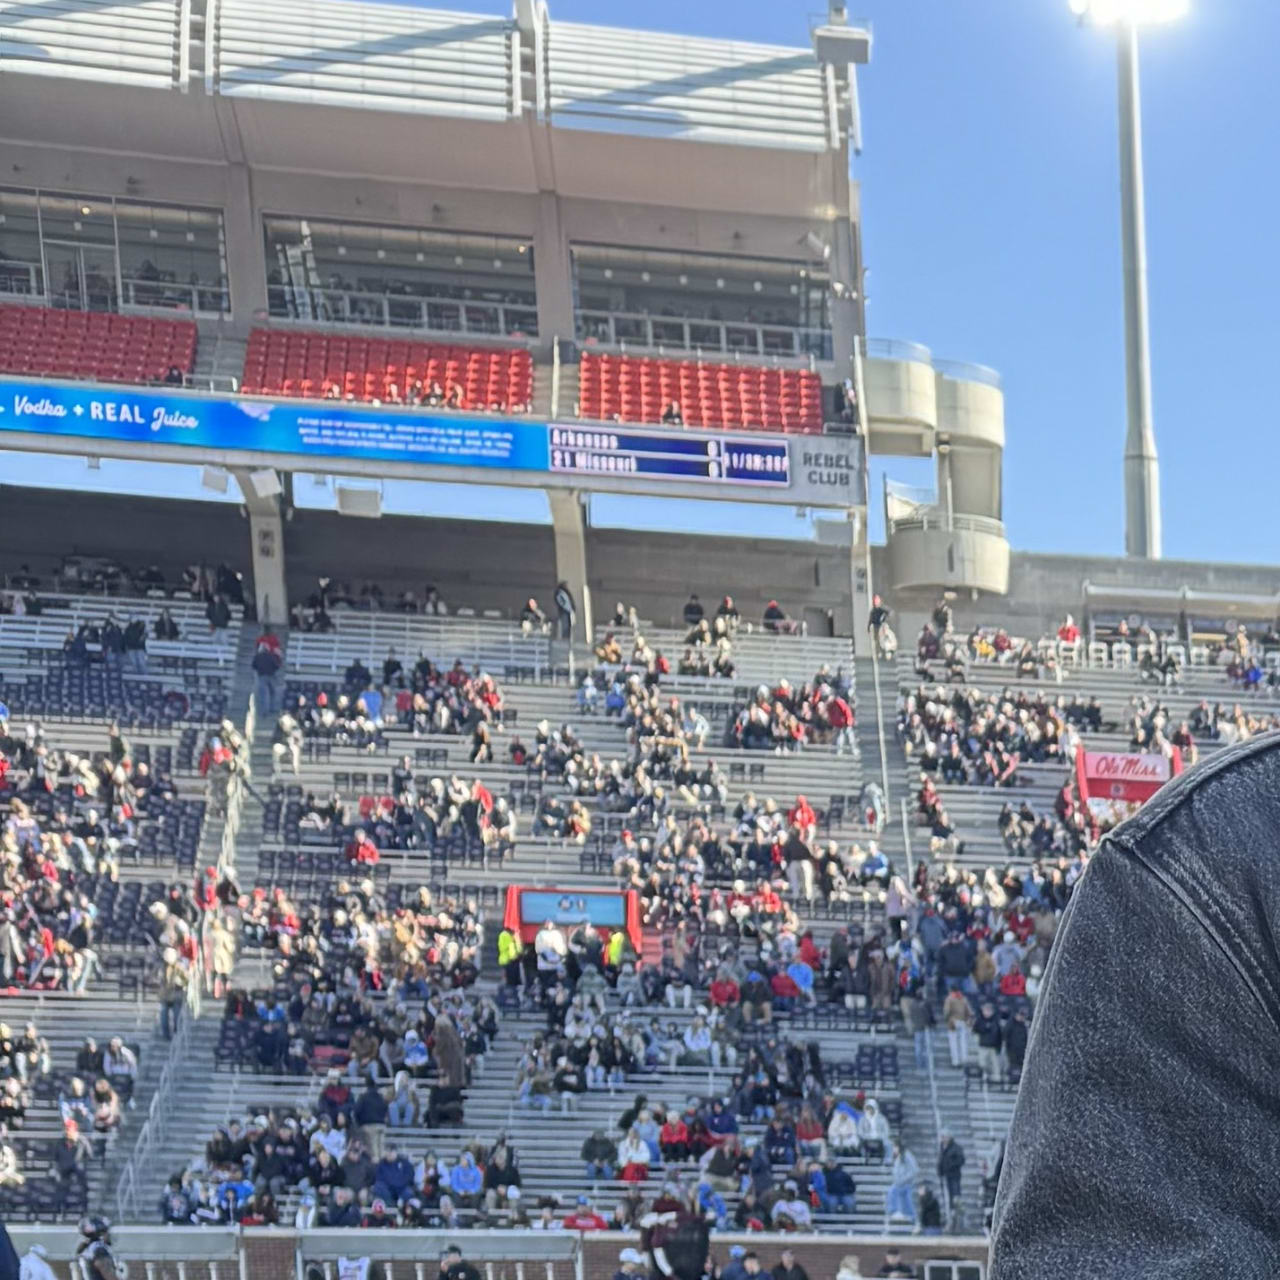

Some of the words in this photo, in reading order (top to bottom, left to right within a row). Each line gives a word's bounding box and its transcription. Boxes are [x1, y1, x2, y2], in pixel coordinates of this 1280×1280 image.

[14, 395, 66, 417] Vodka
[90, 401, 146, 425] REAL
[150, 406, 199, 431] Juice
[803, 452, 855, 470] REBEL
[808, 470, 850, 485] CLUB
